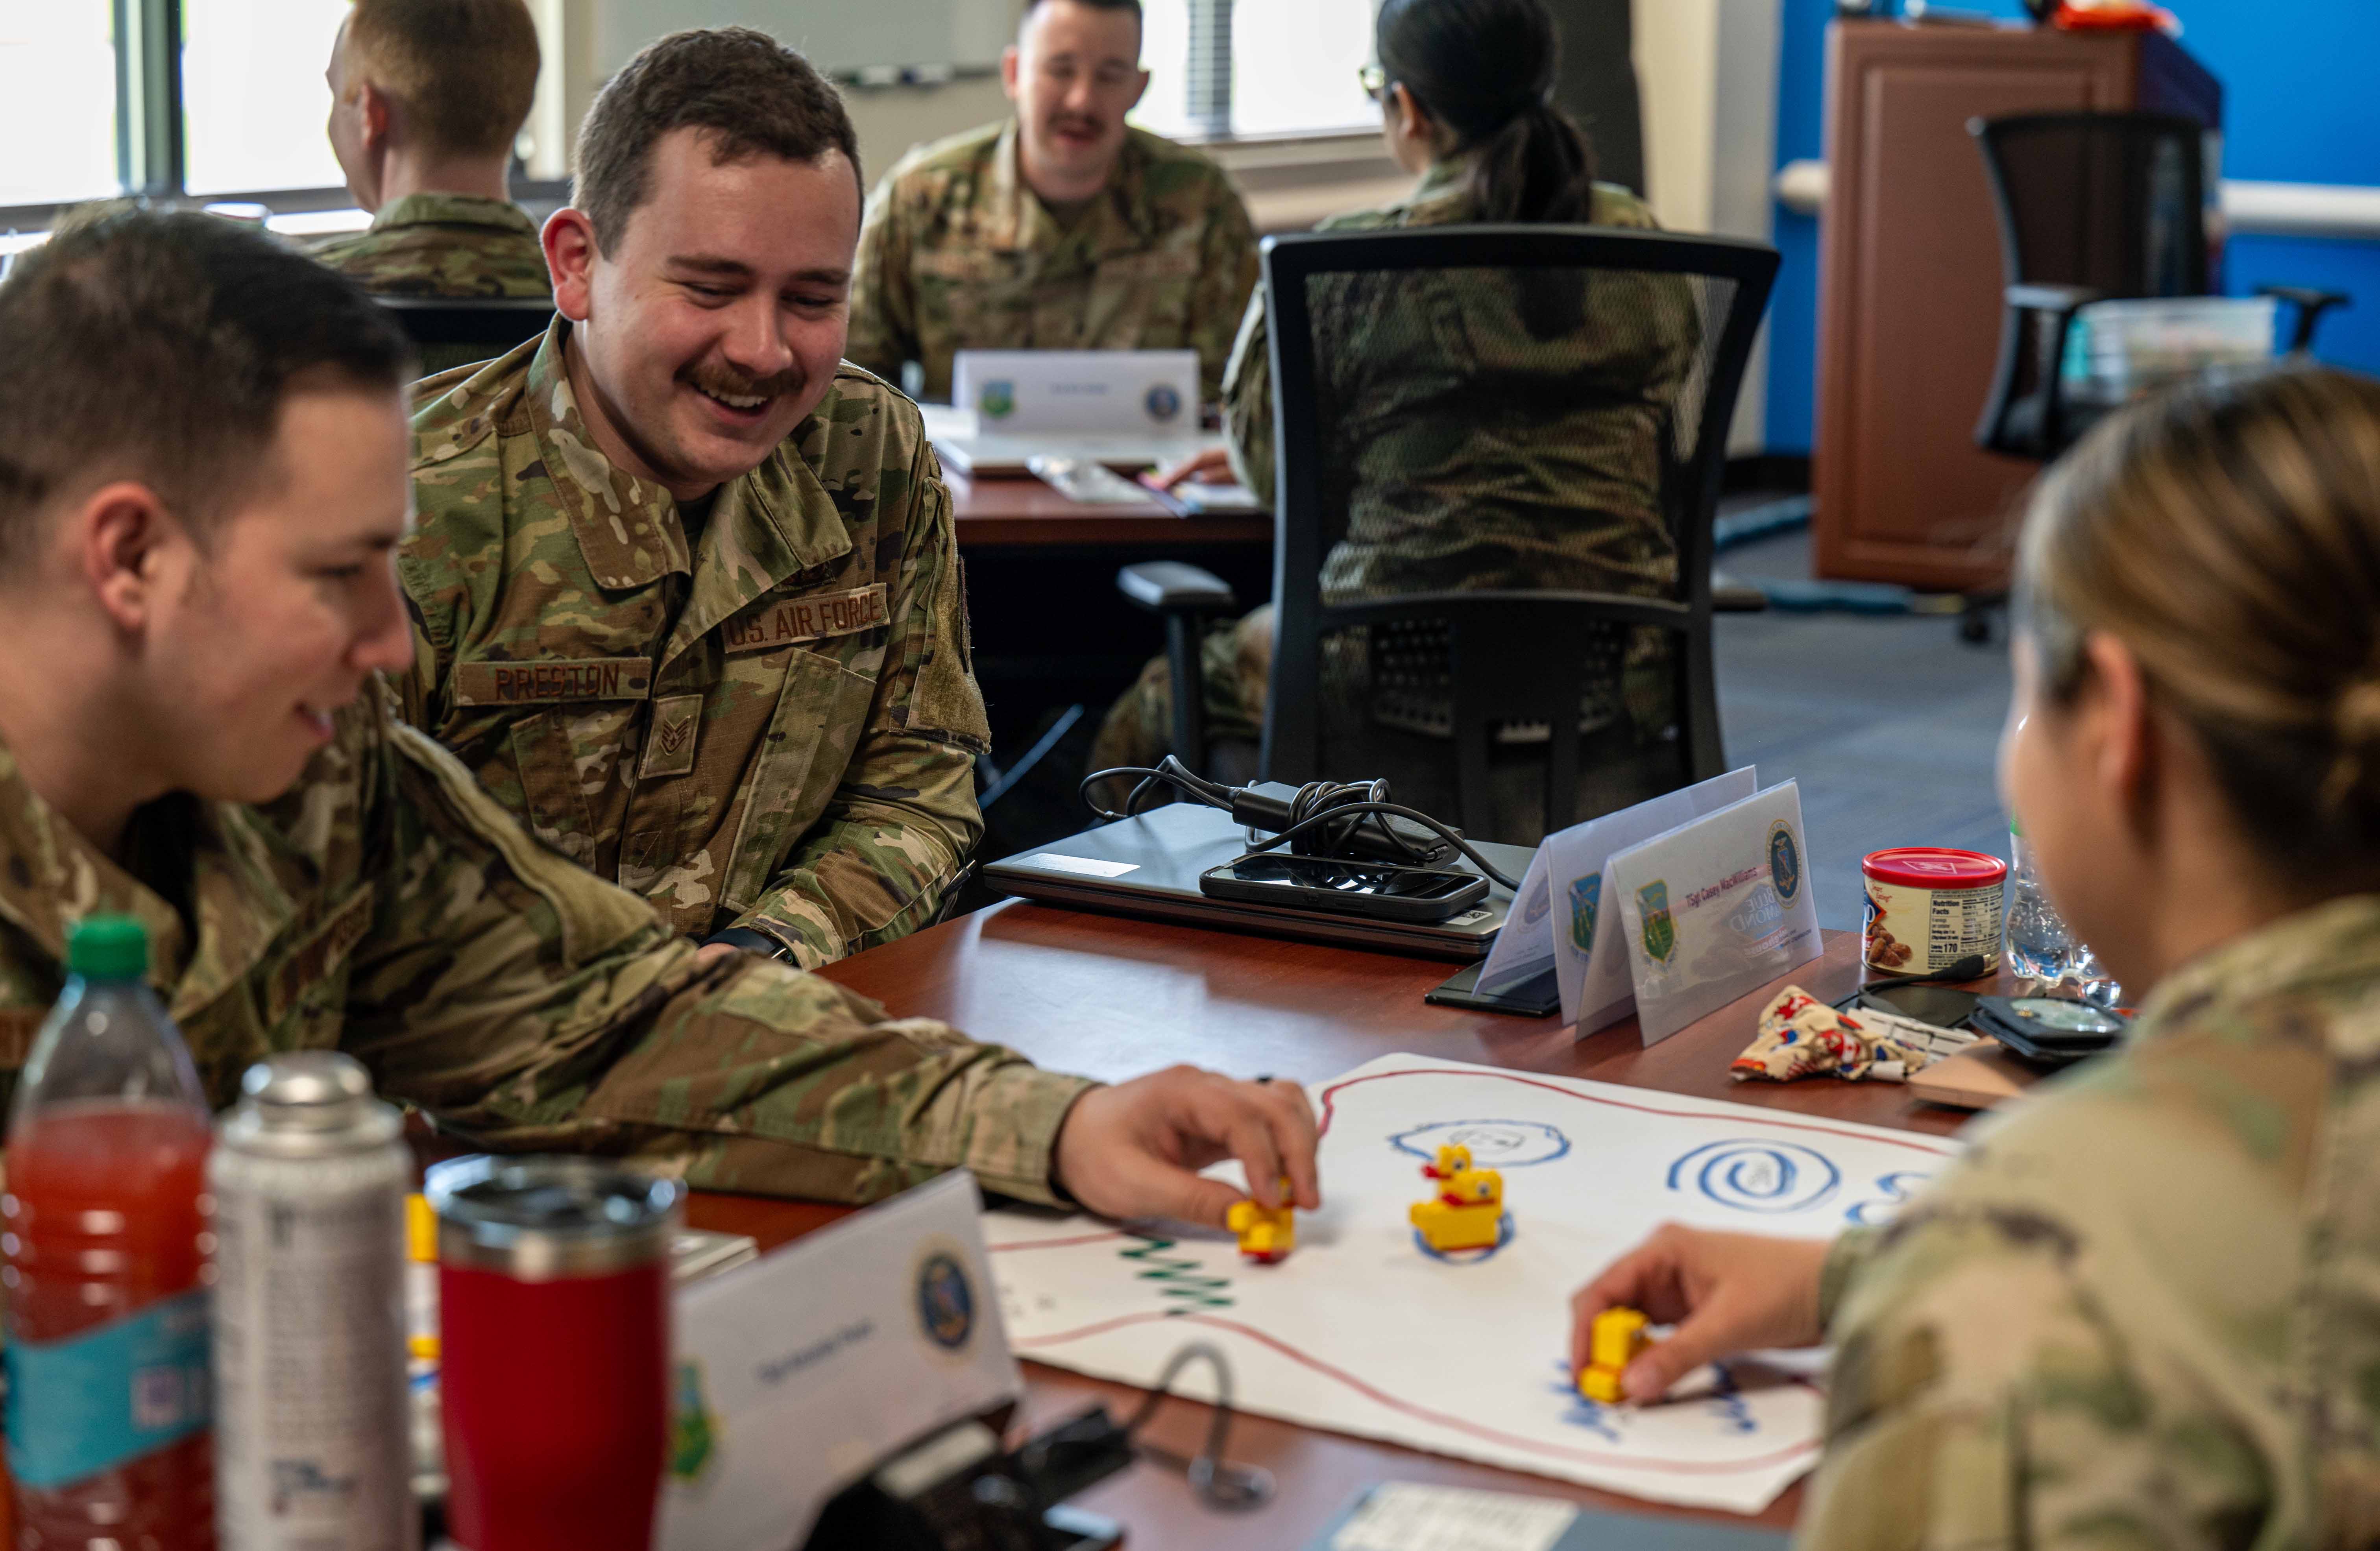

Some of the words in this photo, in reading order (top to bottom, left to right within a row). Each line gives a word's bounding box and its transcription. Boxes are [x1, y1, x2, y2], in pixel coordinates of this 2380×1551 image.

[729, 612, 769, 646] U.S.
[775, 605, 815, 640] AIR
[819, 591, 882, 633] FORCE
[495, 663, 620, 700] PRESTON
[1944, 943, 1958, 953] 170
